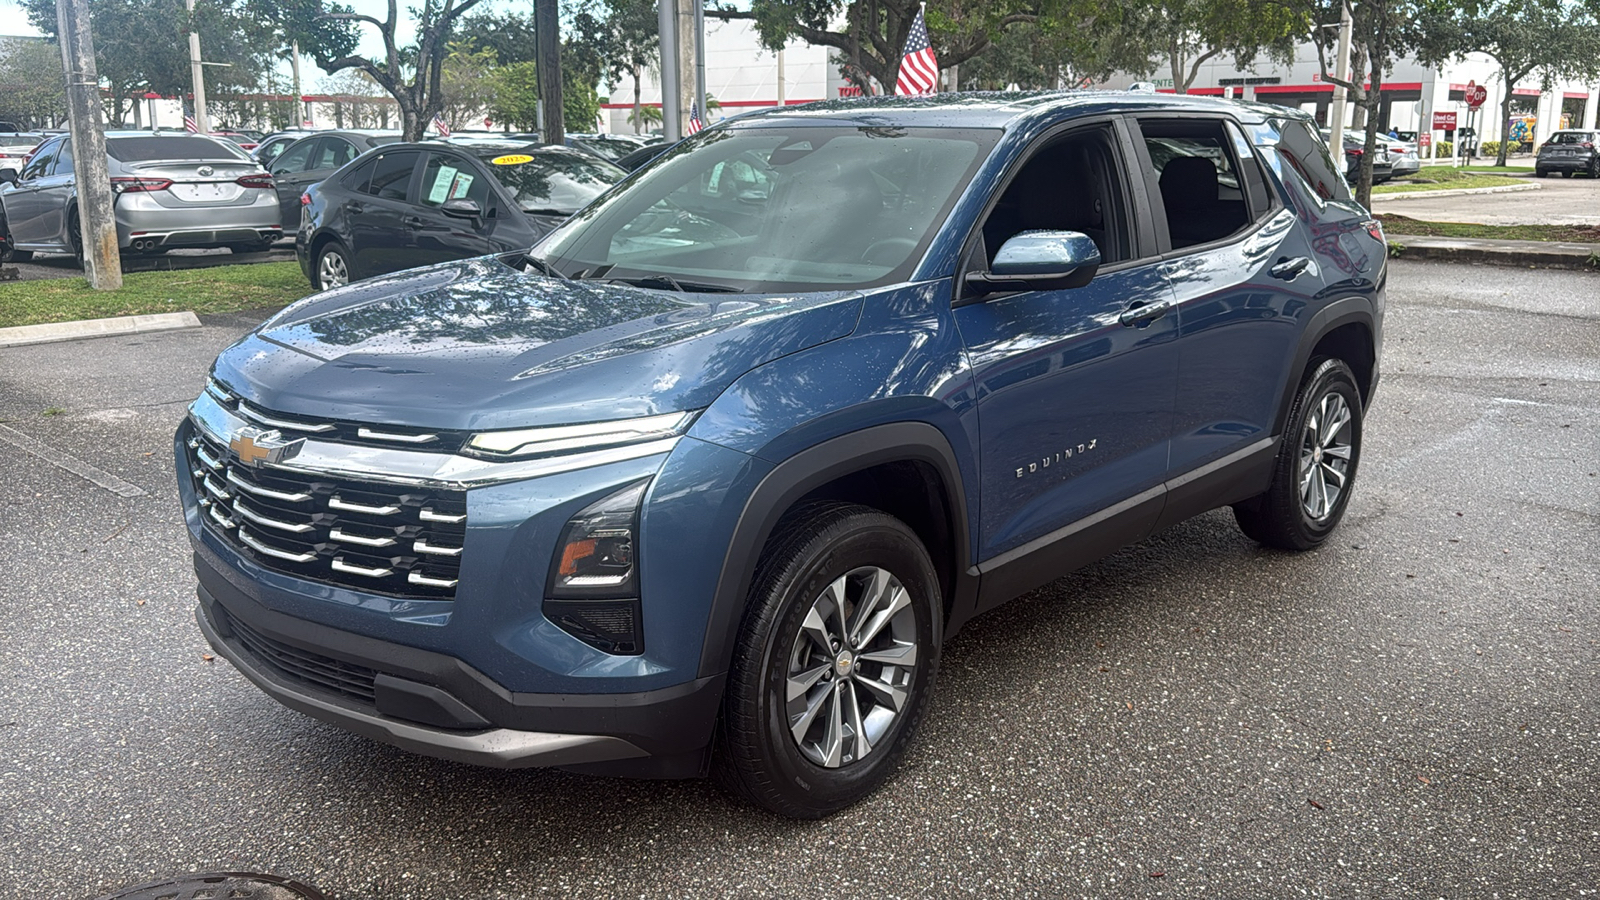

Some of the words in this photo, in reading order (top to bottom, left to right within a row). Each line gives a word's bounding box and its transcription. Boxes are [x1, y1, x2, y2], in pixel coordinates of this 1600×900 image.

[838, 86, 866, 97] TOYO
[1474, 91, 1486, 100] OP
[501, 156, 526, 164] 2025
[1015, 438, 1097, 478] EQUINOX
